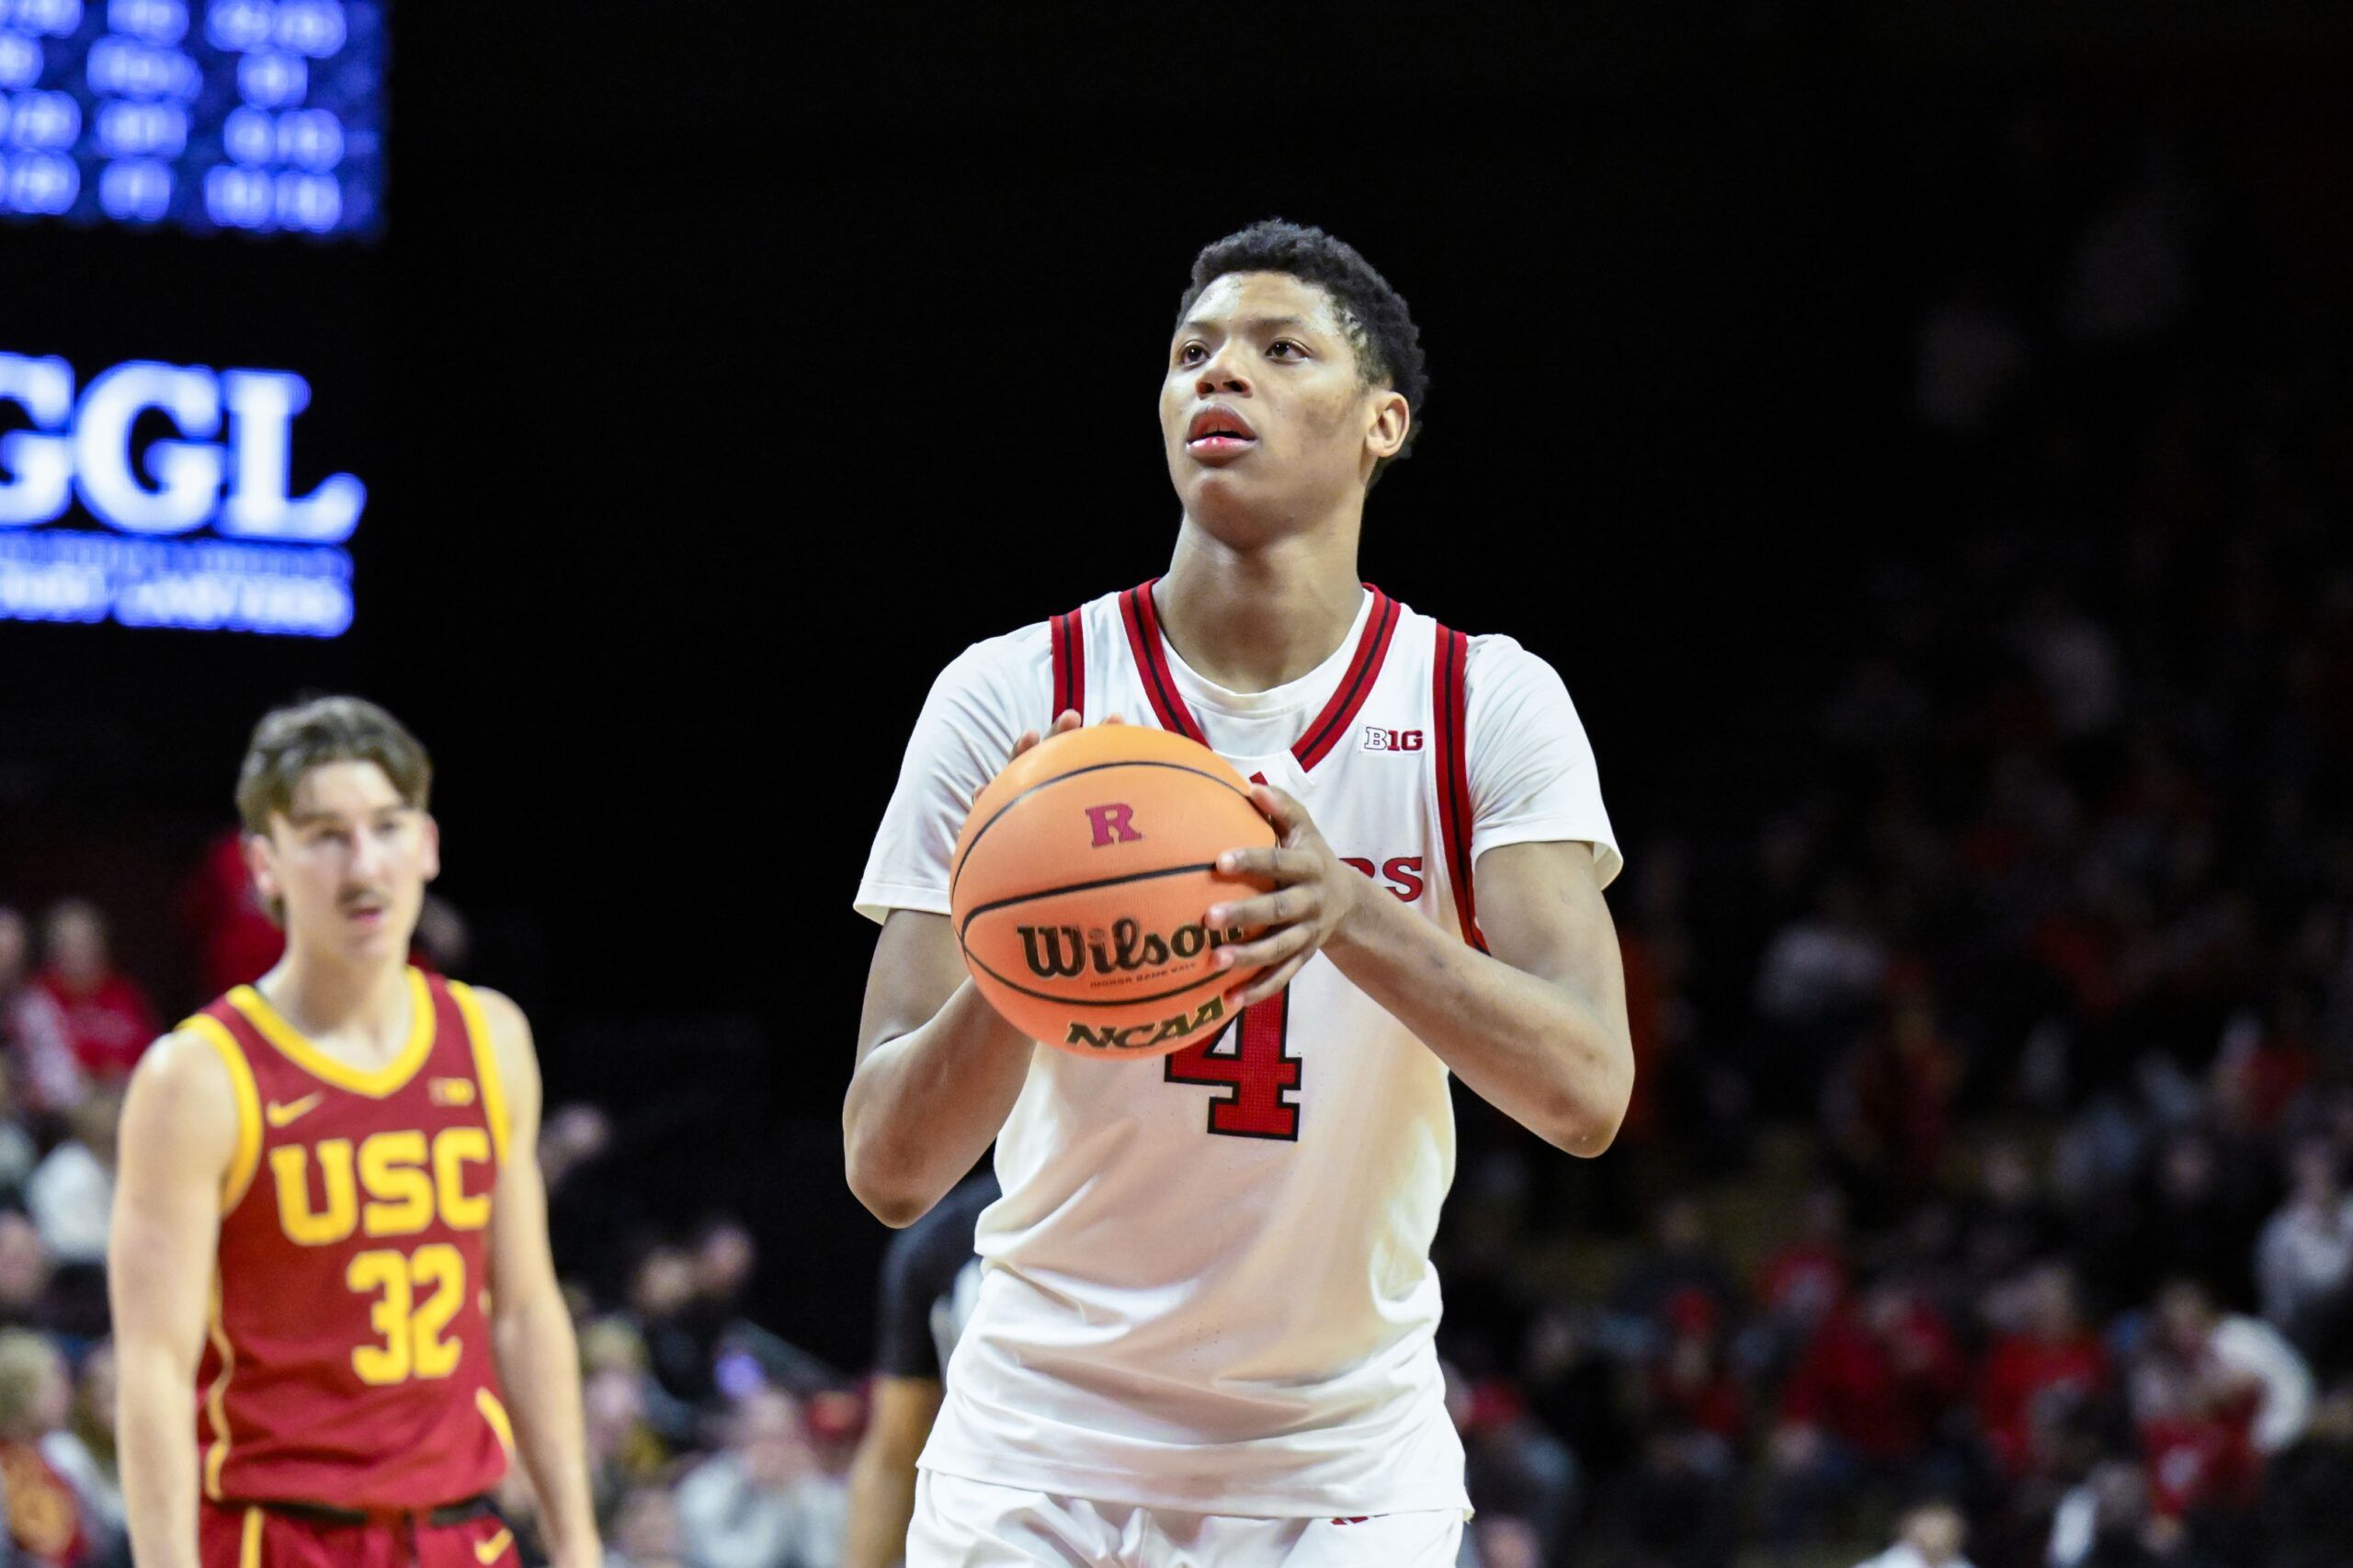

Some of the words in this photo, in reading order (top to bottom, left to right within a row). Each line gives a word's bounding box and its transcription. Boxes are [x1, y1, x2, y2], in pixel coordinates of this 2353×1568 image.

[1364, 726, 1424, 752] BIG
[1085, 802, 1142, 848] R
[1338, 856, 1424, 903] S
[1064, 994, 1225, 1050] NCAA
[1165, 980, 1302, 1142] 4
[270, 1126, 493, 1247] USC
[347, 1244, 465, 1386] 32
